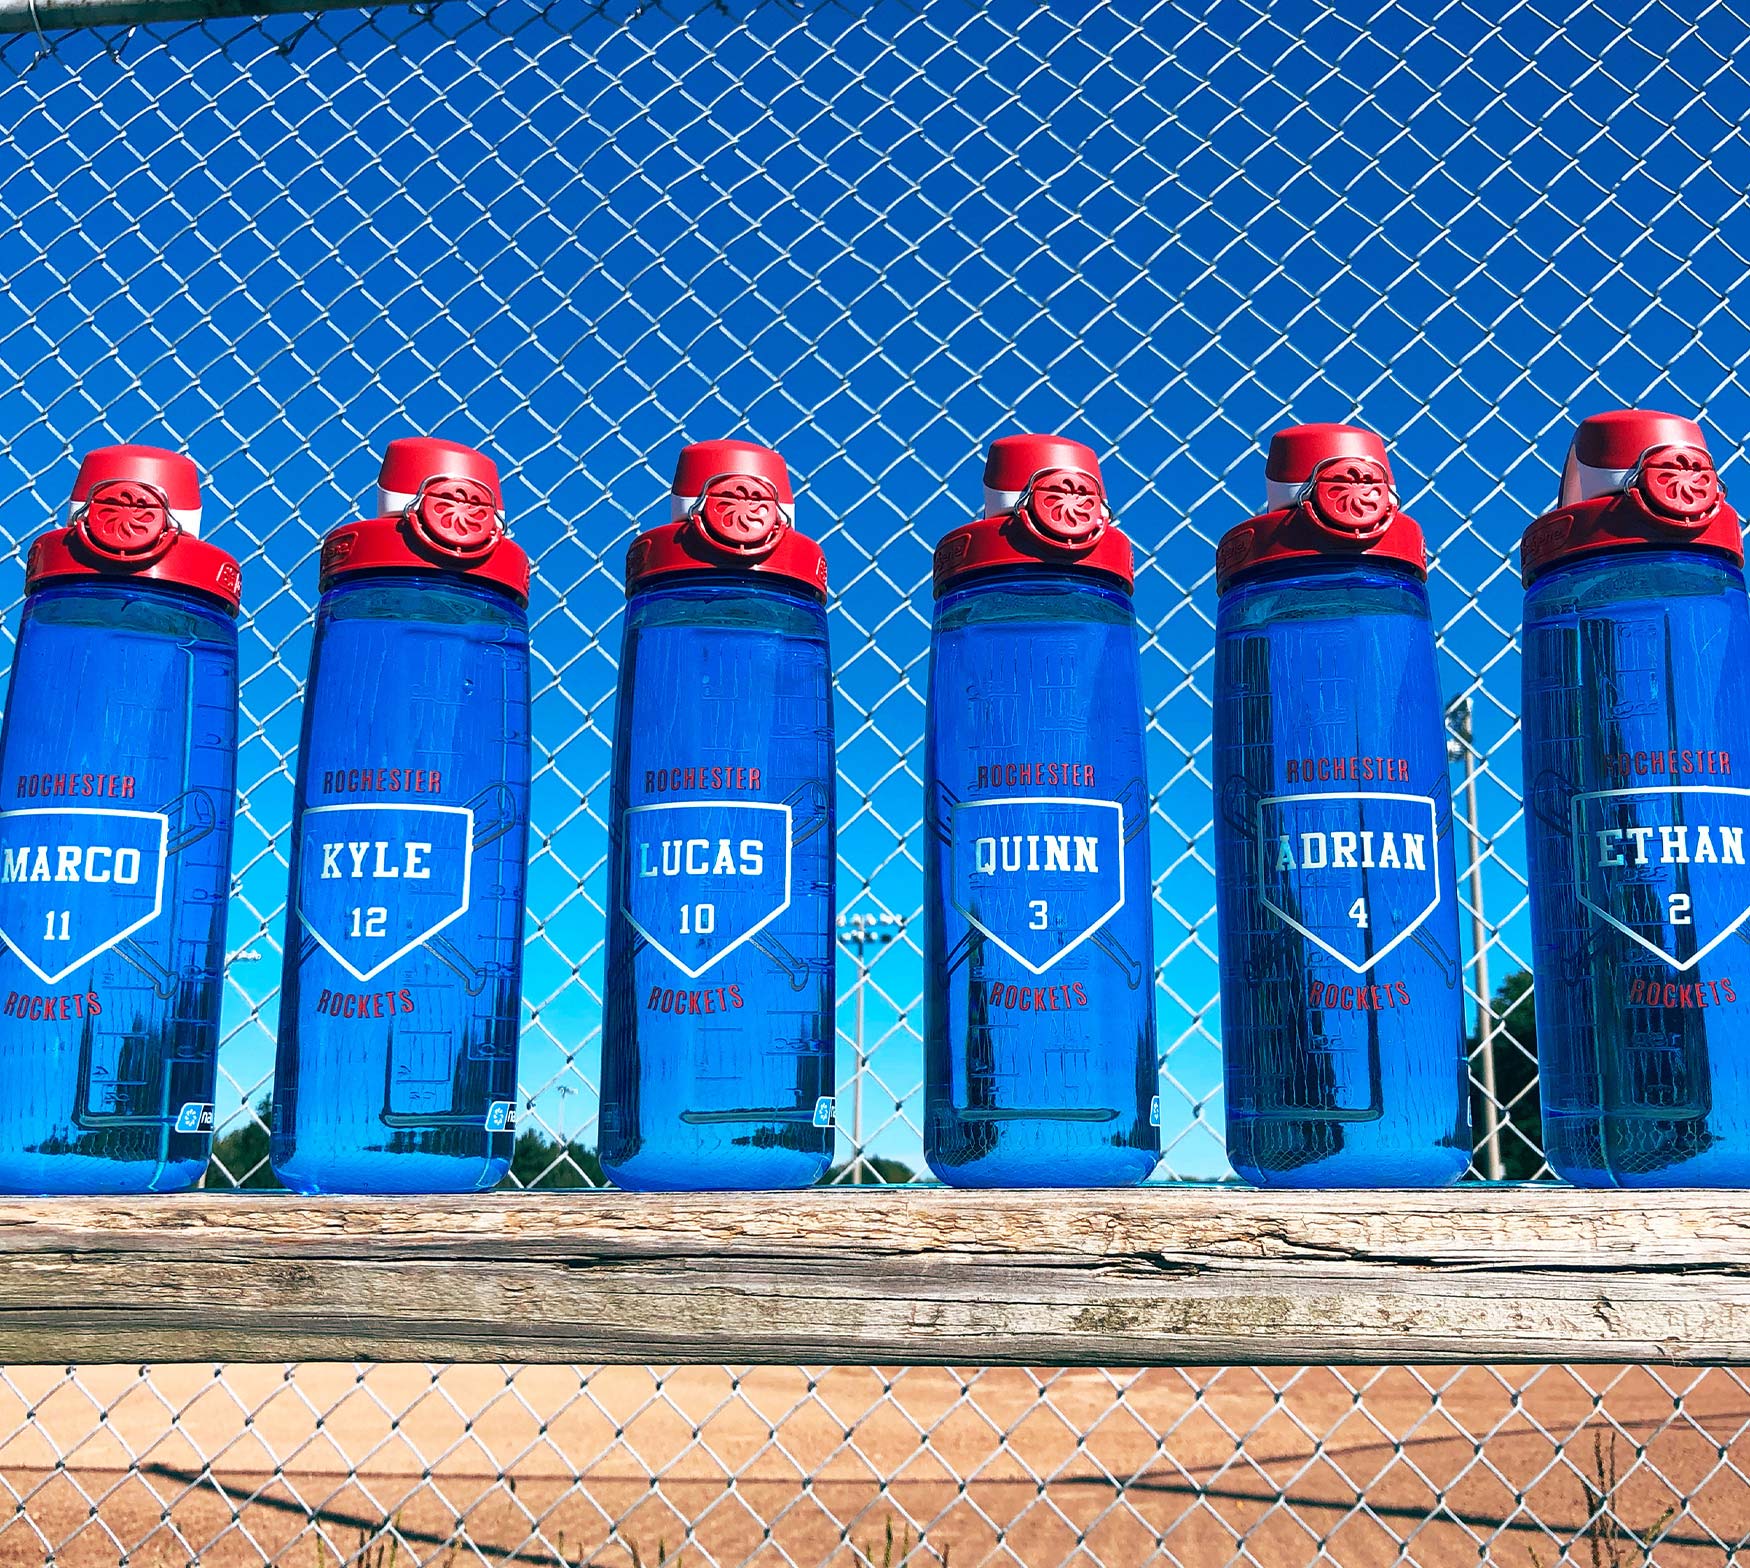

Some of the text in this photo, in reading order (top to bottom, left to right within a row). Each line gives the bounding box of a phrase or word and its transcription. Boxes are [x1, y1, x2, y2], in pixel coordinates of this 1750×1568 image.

[977, 763, 1096, 789] ROCHESTER
[1287, 757, 1409, 783] ROCHESTER
[1602, 750, 1732, 777] ROCHESTER
[17, 774, 136, 798] ROCHESTER
[323, 768, 442, 794] ROCHESTER
[644, 767, 762, 793] ROCHESTER
[320, 841, 432, 879] KYLE
[639, 838, 764, 878] LUCAS
[975, 835, 1099, 876] QUINN
[1275, 831, 1426, 871] ADRIAN
[1596, 825, 1746, 867] ETHAN
[1, 845, 141, 884] MARCO
[351, 906, 387, 937] 12
[679, 903, 715, 934] 10
[1028, 900, 1048, 930] 3
[1348, 897, 1369, 929] 4
[1668, 893, 1691, 925] 2
[43, 910, 71, 941] 11
[3, 991, 103, 1020] ROCKETS
[317, 989, 415, 1019] ROCKETS
[647, 984, 744, 1015] ROCKETS
[989, 981, 1089, 1011] ROCKETS
[1309, 980, 1411, 1011] ROCKETS
[1630, 977, 1737, 1009] ROCKETS
